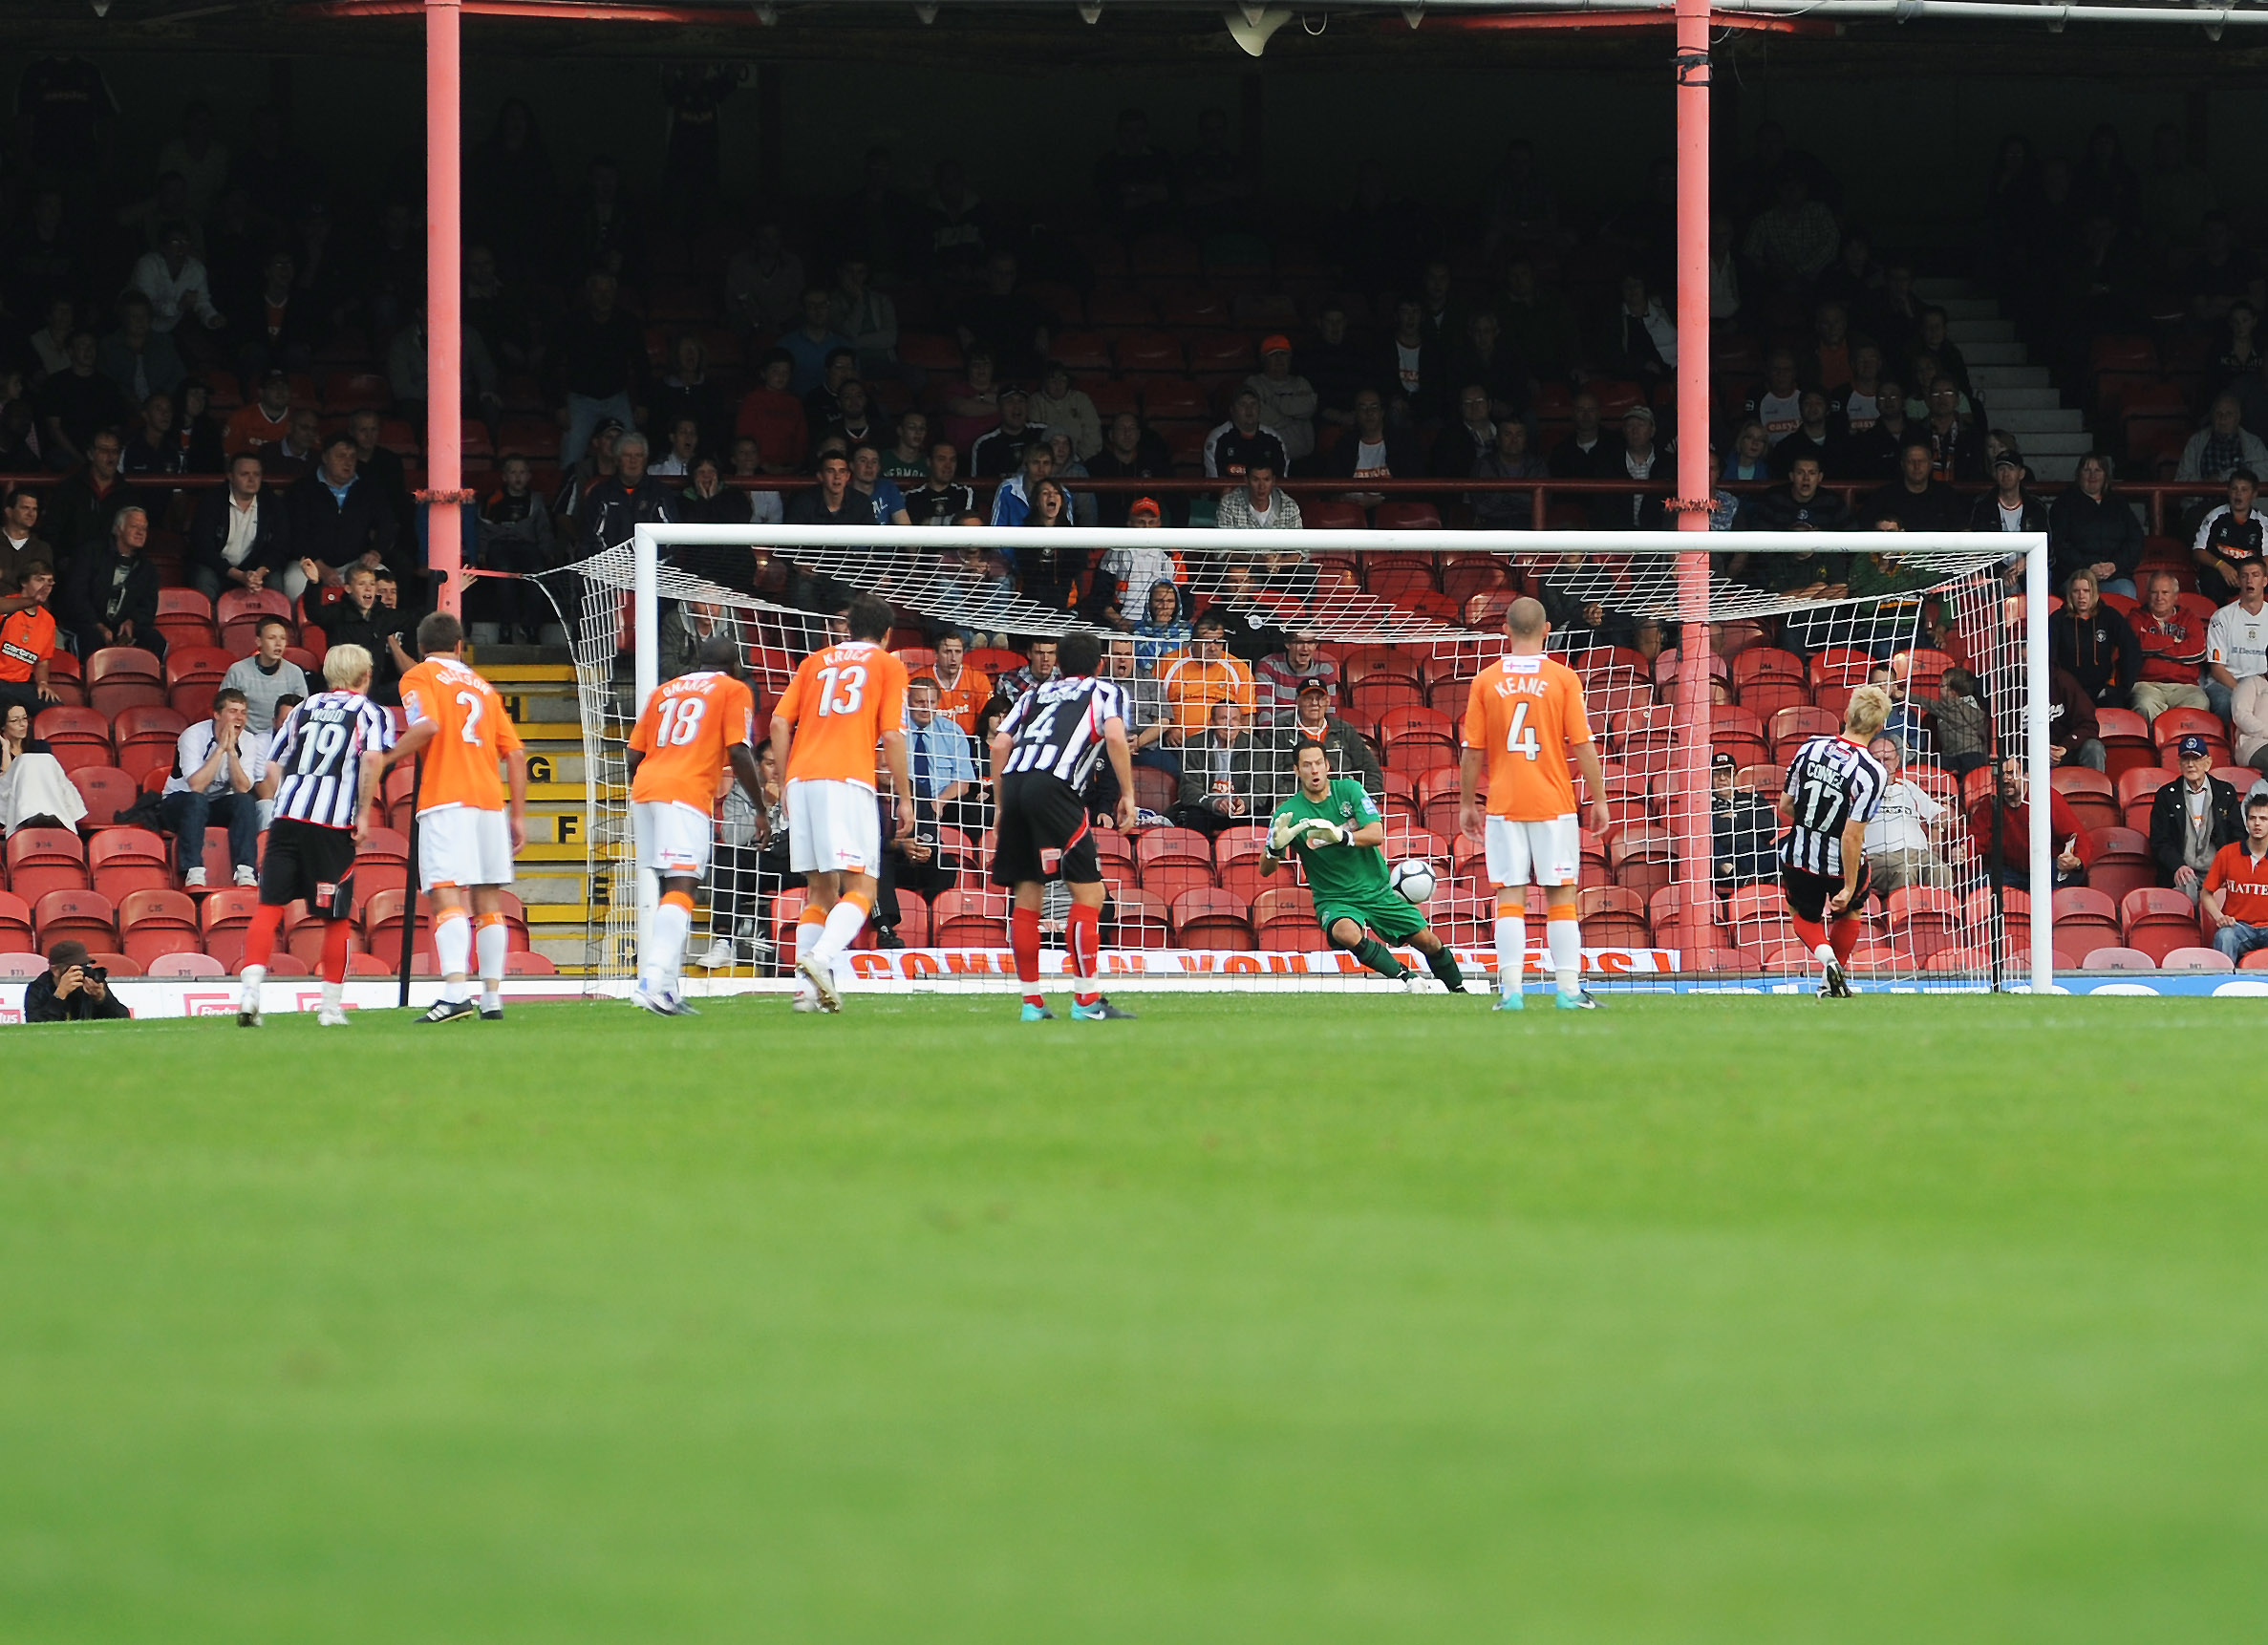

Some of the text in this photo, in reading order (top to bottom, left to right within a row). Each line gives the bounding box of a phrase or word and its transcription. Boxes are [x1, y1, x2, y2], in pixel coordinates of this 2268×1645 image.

[503, 696, 521, 722] H
[817, 665, 867, 716] 13
[1494, 676, 1549, 698] KEANE
[456, 691, 483, 747] 2
[657, 696, 705, 747] 18
[1024, 700, 1062, 743] 4
[1507, 701, 1541, 761] 4
[298, 721, 348, 776] 19
[526, 756, 551, 783] G
[1803, 780, 1844, 832] 17
[558, 816, 578, 844] F
[592, 876, 610, 905] E
